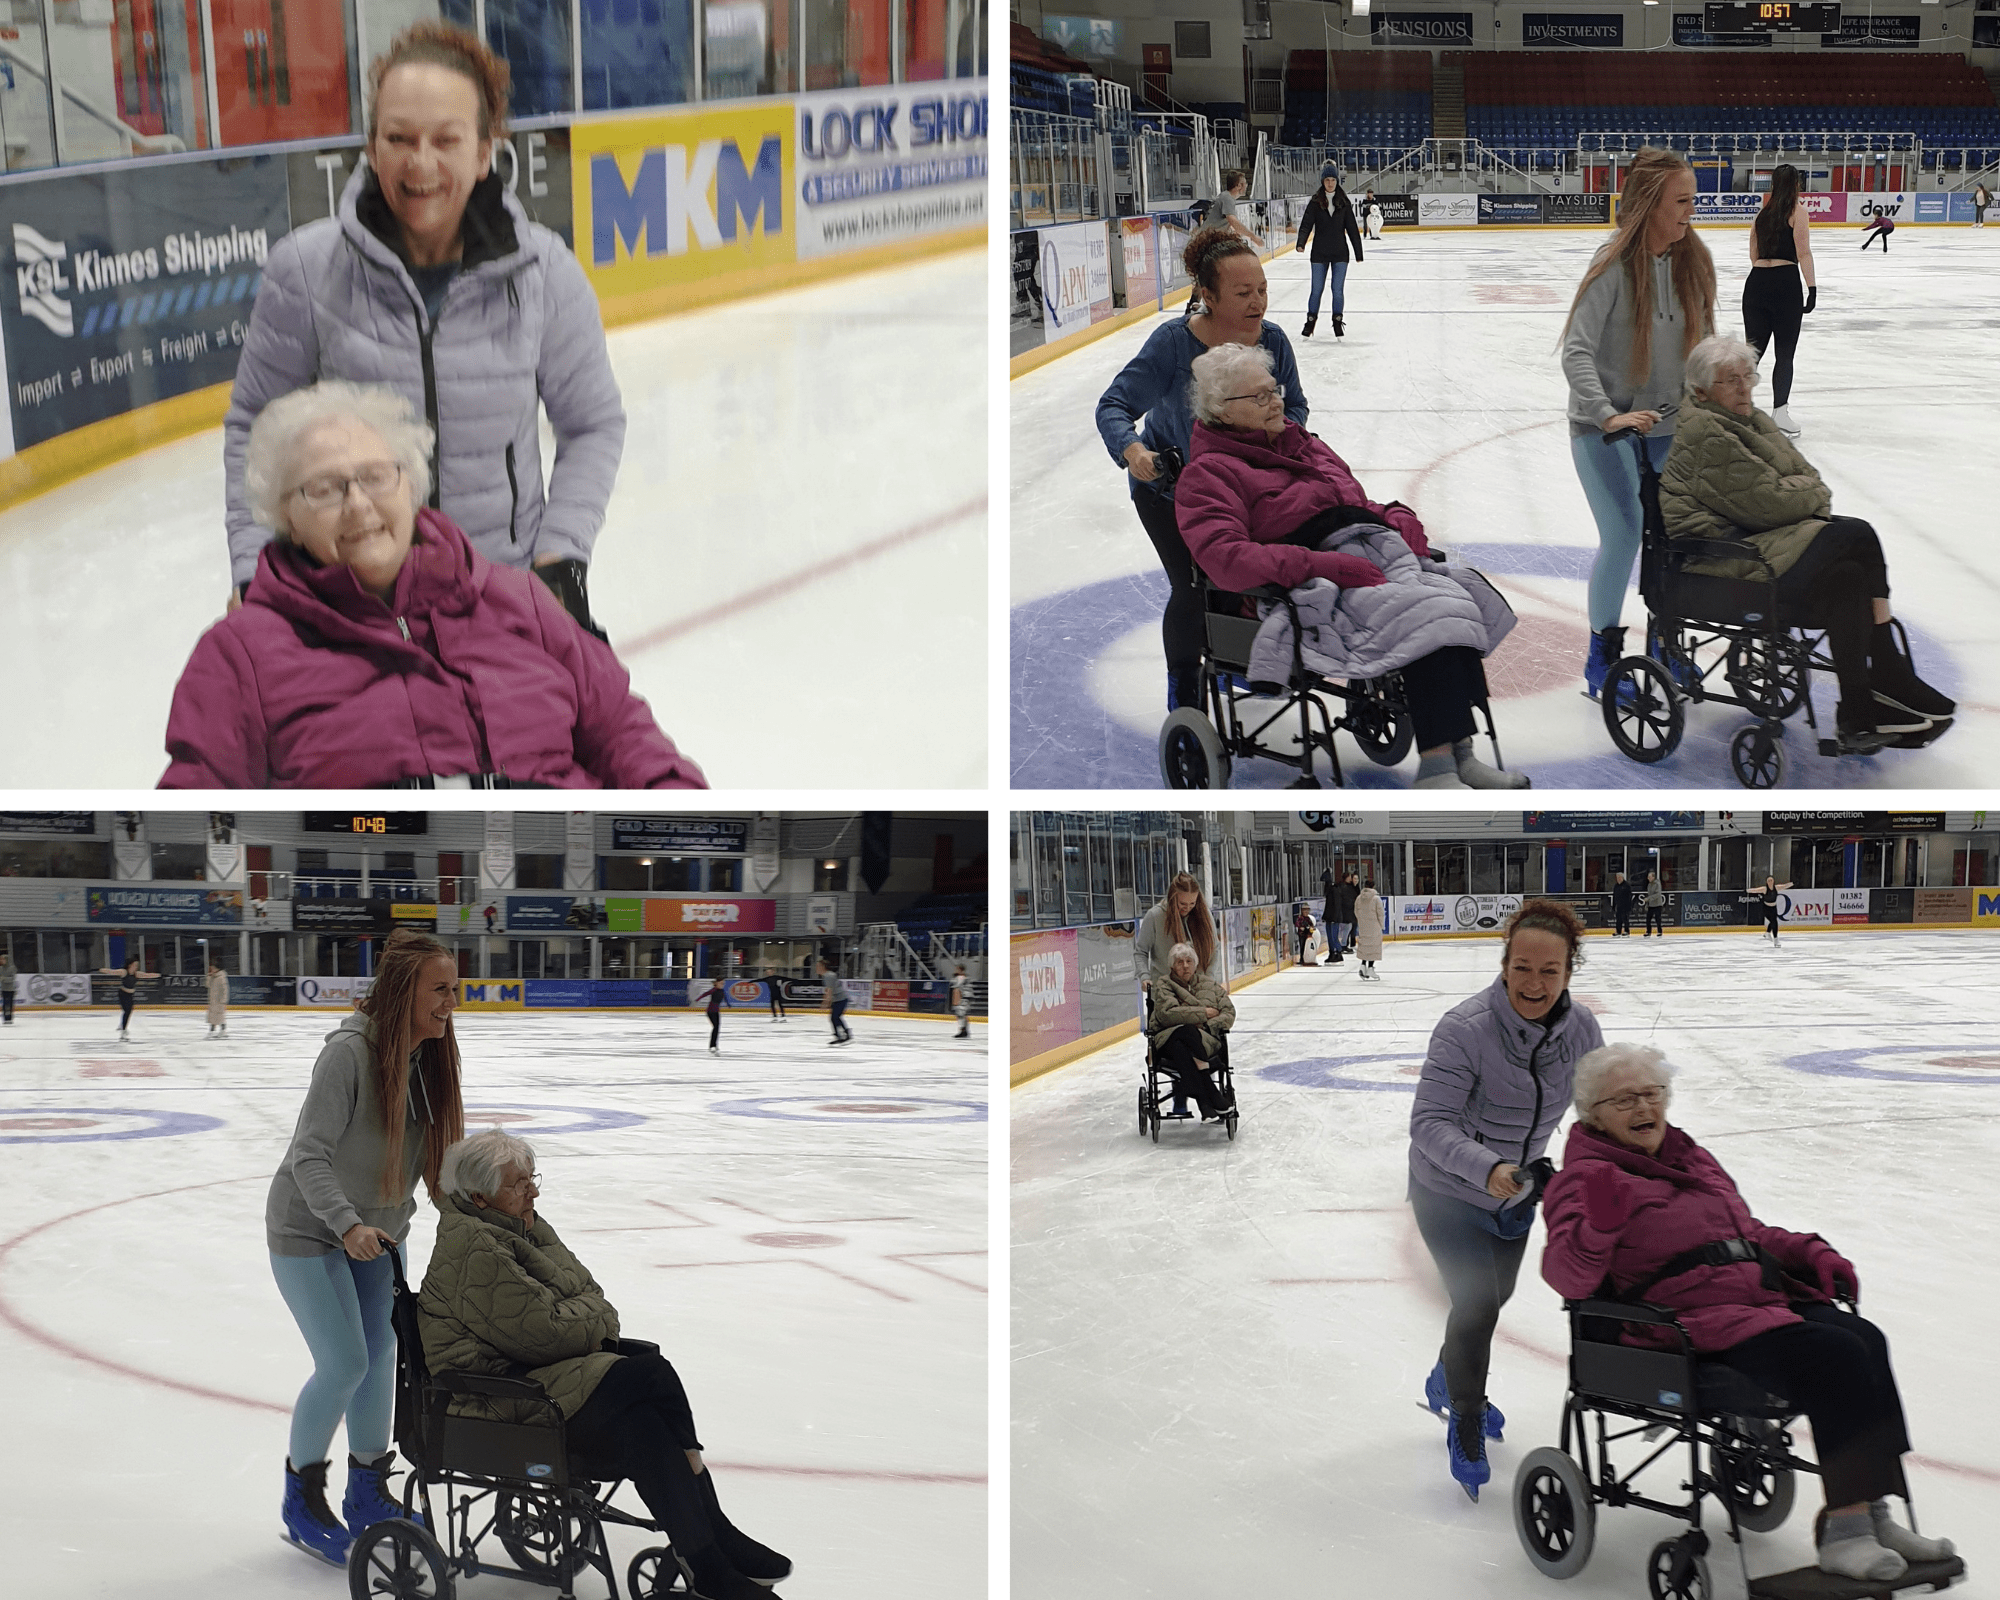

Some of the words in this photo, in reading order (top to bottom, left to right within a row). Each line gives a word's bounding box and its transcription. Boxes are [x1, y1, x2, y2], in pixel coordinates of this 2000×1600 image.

[1760, 3, 1791, 18] 10:57
[1676, 16, 1697, 25] GKD
[1377, 20, 1467, 37] PENSIONS
[1528, 25, 1618, 37] INVESTMENTS
[1892, 28, 1916, 36] COVER
[801, 101, 900, 160] LOCK
[590, 132, 783, 270] MKM
[1383, 202, 1405, 210] MAINS
[1549, 195, 1605, 206] TAYSIDE
[1721, 195, 1762, 206] SHOP
[1384, 210, 1414, 218] JOINERY
[75, 247, 160, 294] Kinnes
[163, 224, 269, 277] Shipping
[18, 370, 64, 408] Import
[91, 350, 135, 385] Export
[161, 330, 209, 364] Freight
[1770, 812, 1801, 821] Outplay
[1803, 811, 1815, 819] the
[1817, 811, 1865, 820] Competition.
[1840, 892, 1862, 900] 01382
[1684, 904, 1701, 912] We.
[1702, 903, 1733, 912] Create.
[1684, 911, 1723, 920] Demand.
[1084, 962, 1107, 984] ALTAR
[466, 984, 520, 1002] MKM
